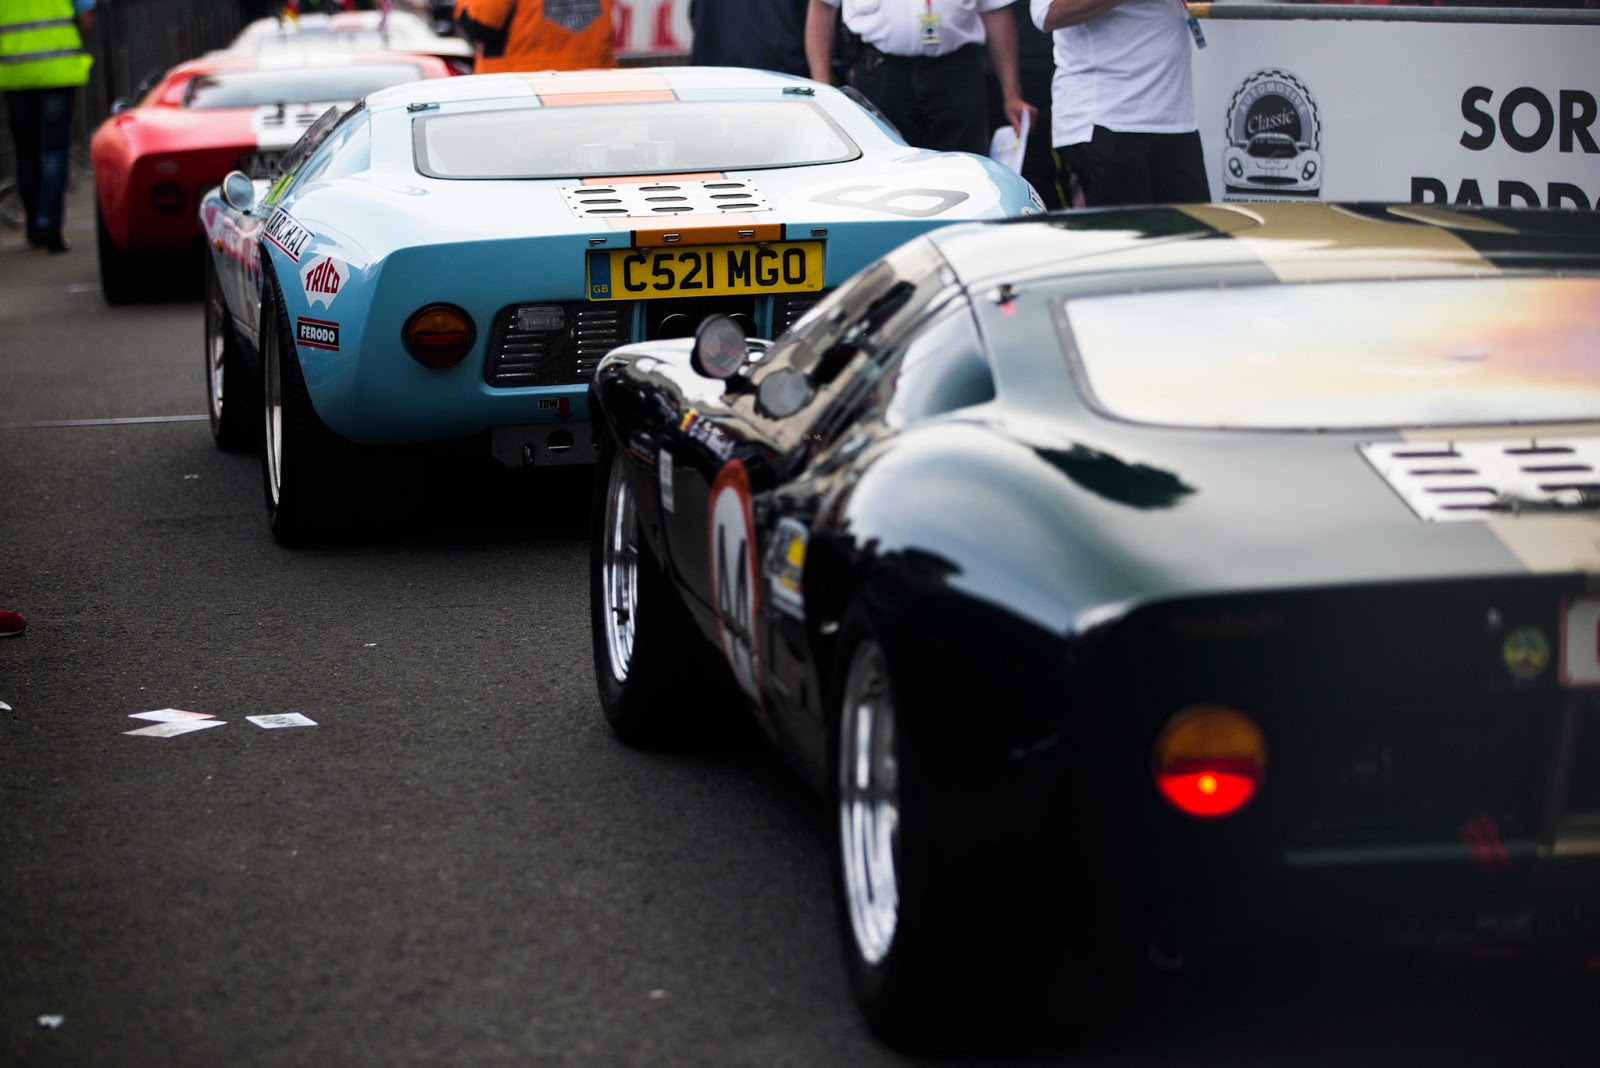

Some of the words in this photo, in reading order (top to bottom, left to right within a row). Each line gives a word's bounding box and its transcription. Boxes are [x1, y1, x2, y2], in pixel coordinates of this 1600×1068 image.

[1240, 82, 1307, 113] AUTOMOTIVE
[1247, 108, 1294, 133] Classic
[1460, 86, 1600, 153] SOR
[305, 257, 341, 294] TRICO
[623, 251, 714, 292] C521
[727, 247, 806, 288] MGO
[593, 284, 609, 294] GB
[301, 325, 335, 343] FERODO
[538, 398, 558, 409] TOW
